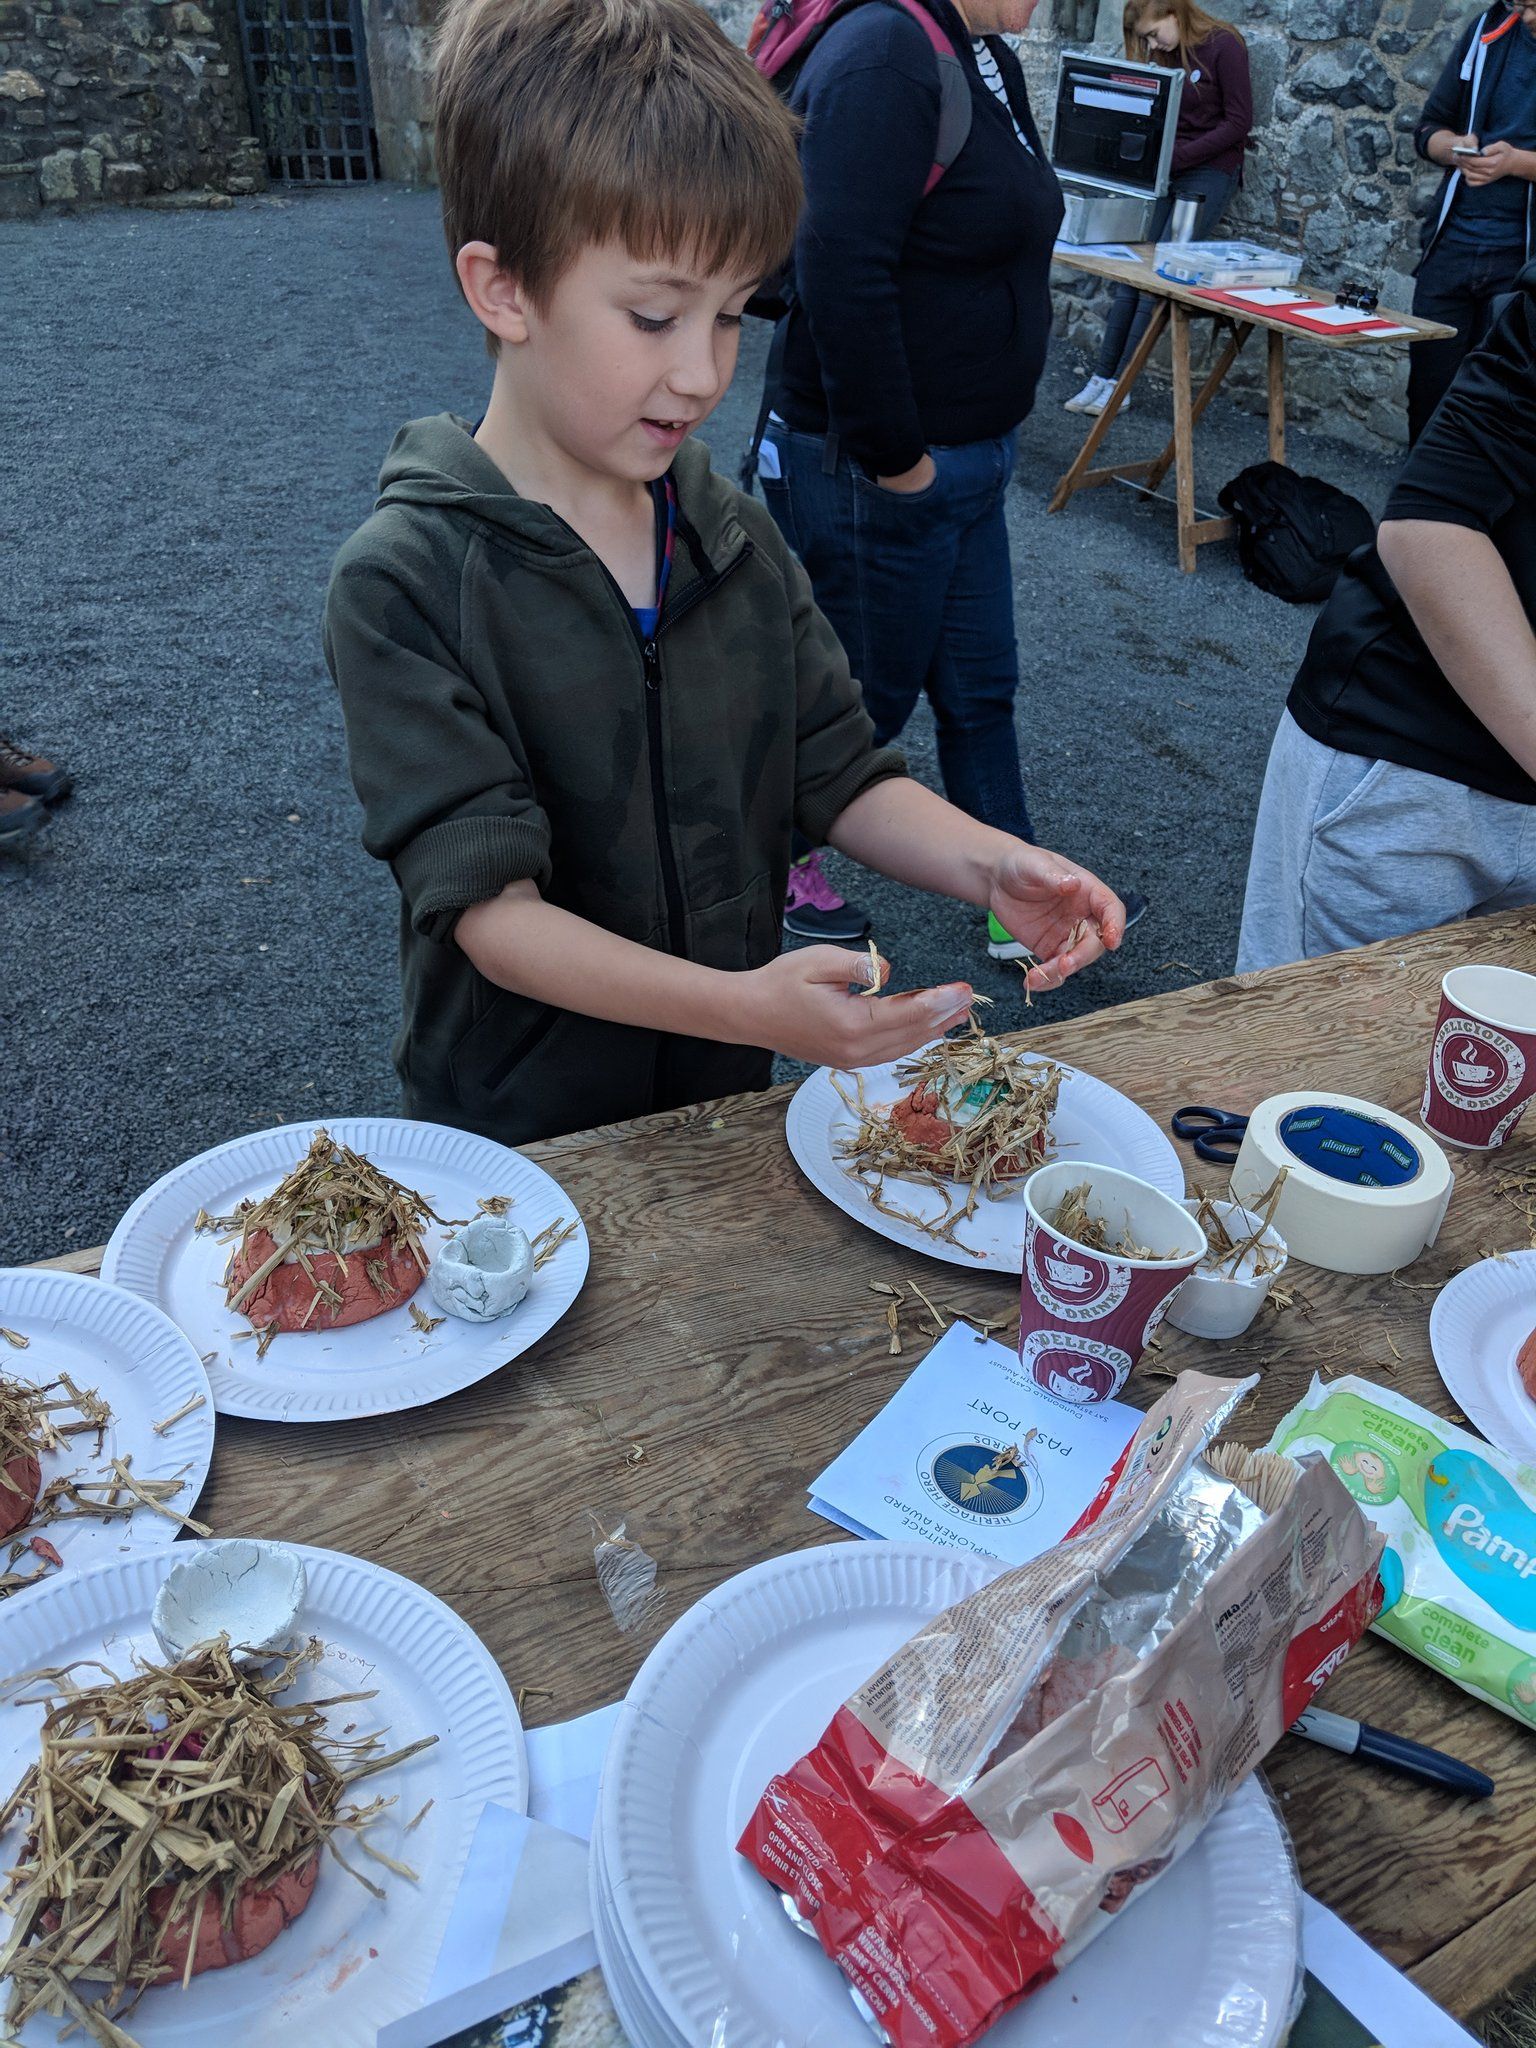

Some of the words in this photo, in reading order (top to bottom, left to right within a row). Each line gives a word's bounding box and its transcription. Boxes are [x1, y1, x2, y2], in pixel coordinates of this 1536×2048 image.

[1439, 1081, 1463, 1107] HOT
[1322, 1140, 1360, 1156] ultratape
[1032, 1281, 1063, 1313] HOT
[989, 1360, 1019, 1378] AUGUST
[1005, 1375, 1032, 1393] CASTLE
[967, 1399, 1022, 1431] PORT
[1362, 1409, 1429, 1451] complete
[1022, 1431, 1073, 1457] PAS
[1363, 1420, 1417, 1456] clean
[920, 1471, 943, 1500] HERO
[883, 1495, 934, 1529] AWARD
[942, 1499, 1012, 1525] HERITAGE
[901, 1517, 960, 1549] RITAGE
[1421, 1606, 1490, 1649] complete
[1421, 1625, 1476, 1663] clean
[866, 1659, 902, 1693] AVVERTENZE:
[769, 1831, 787, 1852] OPEN
[786, 1849, 803, 1866] AND
[803, 1864, 823, 1891] CLOSE
[774, 1819, 793, 1837] APRI
[796, 1841, 823, 1870] CHIUDI
[762, 1844, 789, 1873] OUVRIR
[789, 1870, 800, 1881] ET
[836, 1952, 859, 1979] ABRE
[861, 1982, 887, 2015] FECHA
[847, 1943, 869, 1968] ABRE
[873, 1972, 900, 2008] CIERRA
